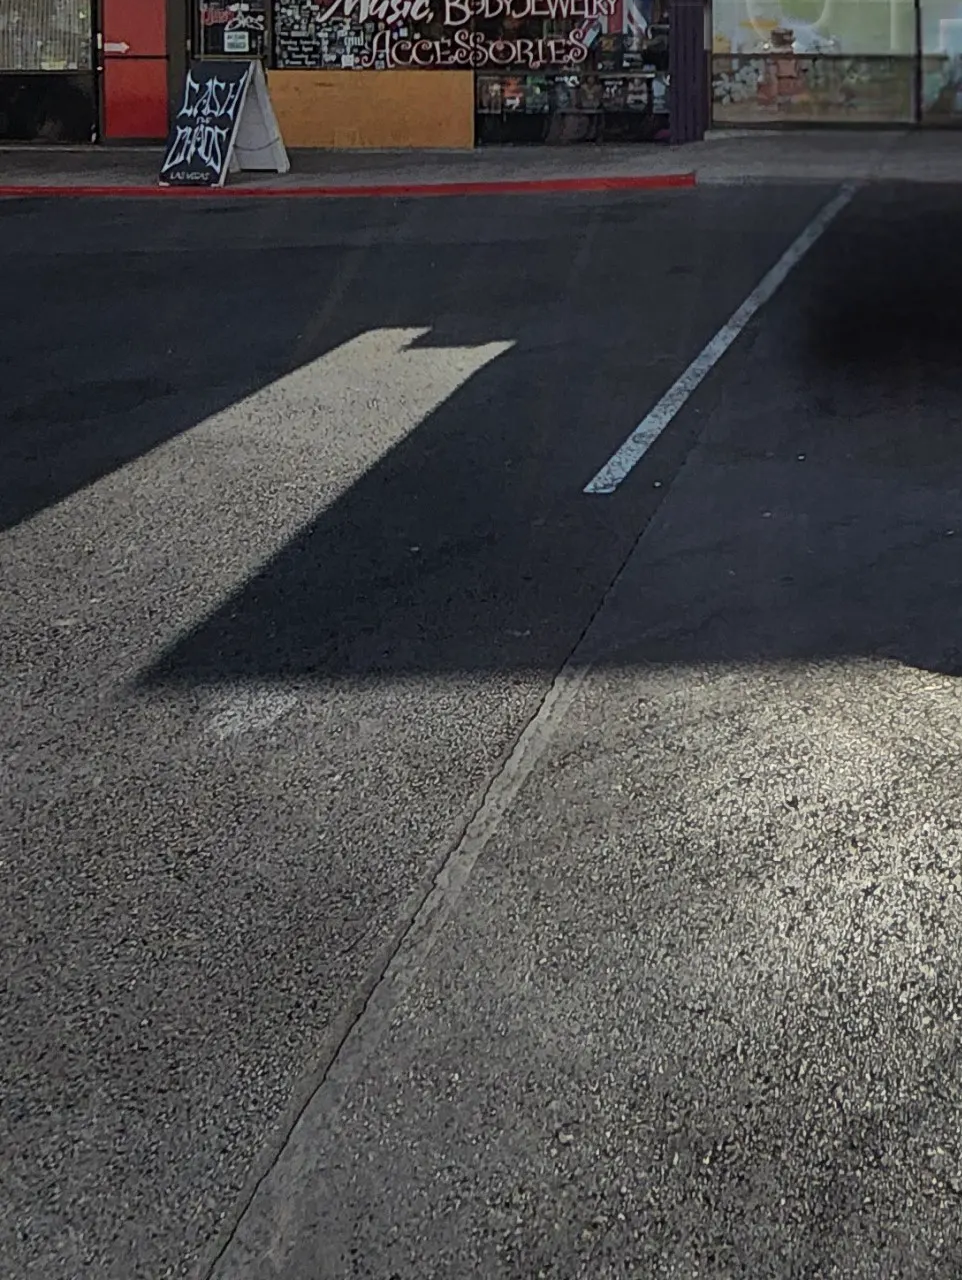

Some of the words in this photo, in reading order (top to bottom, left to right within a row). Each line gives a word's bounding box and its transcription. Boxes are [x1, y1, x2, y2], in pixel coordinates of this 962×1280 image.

[361, 27, 589, 70] ACCESSORIES
[177, 68, 249, 123] CASH
[160, 123, 230, 175] CHAOS
